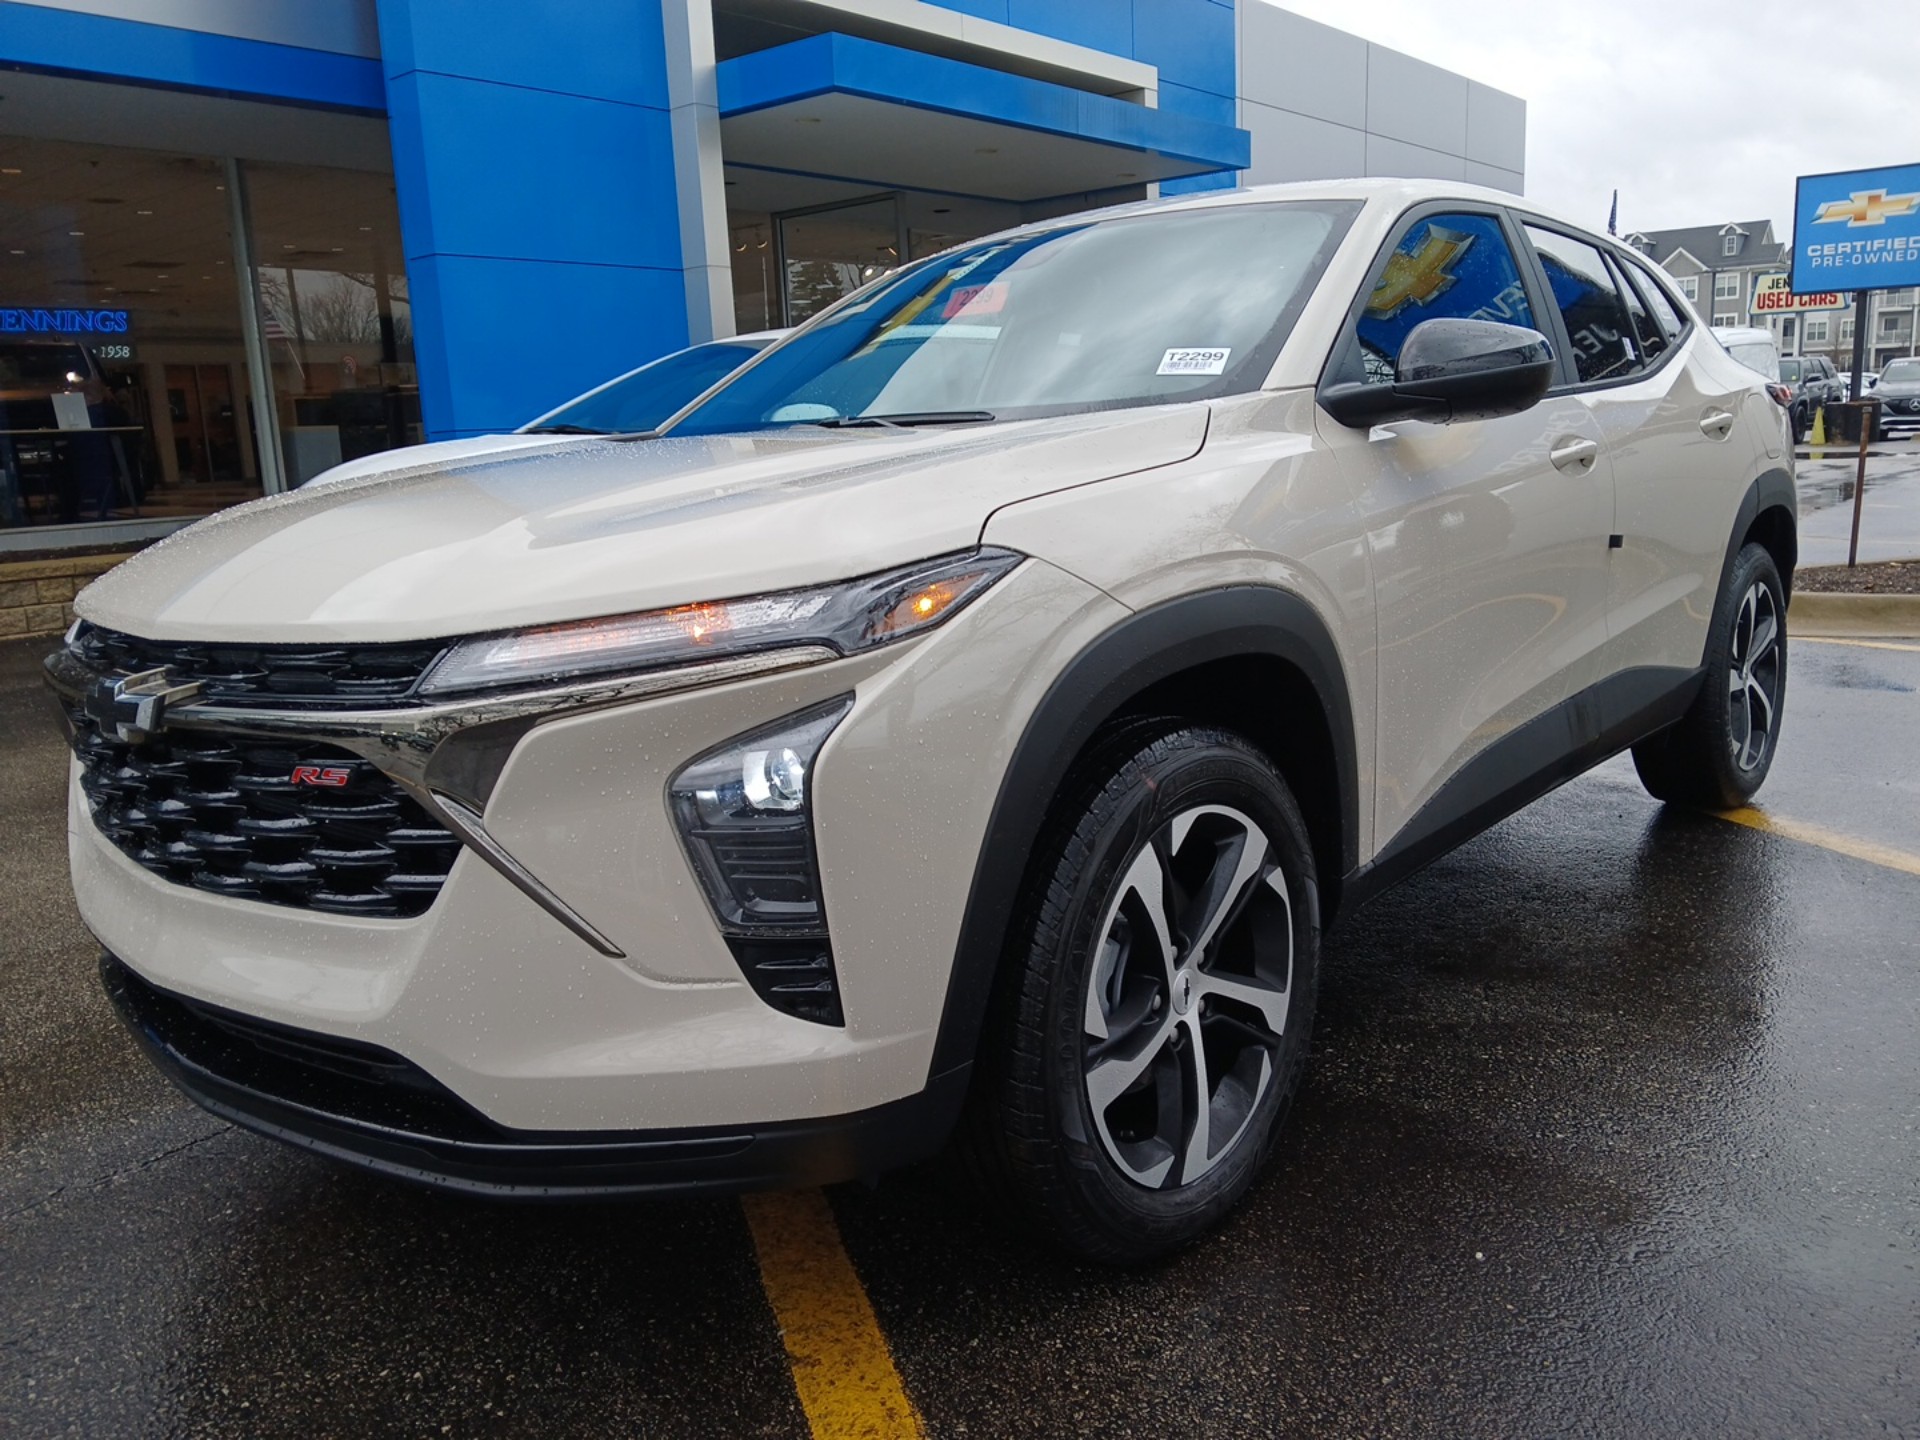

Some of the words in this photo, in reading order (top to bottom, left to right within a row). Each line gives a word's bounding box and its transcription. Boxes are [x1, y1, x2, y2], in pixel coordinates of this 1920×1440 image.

[1811, 249, 1918, 268] PRE-OWNED
[1757, 291, 1794, 310] USED
[1799, 292, 1838, 307] CARS
[101, 346, 130, 358] 1958
[1168, 351, 1224, 361] T2299
[291, 766, 350, 786] RS
